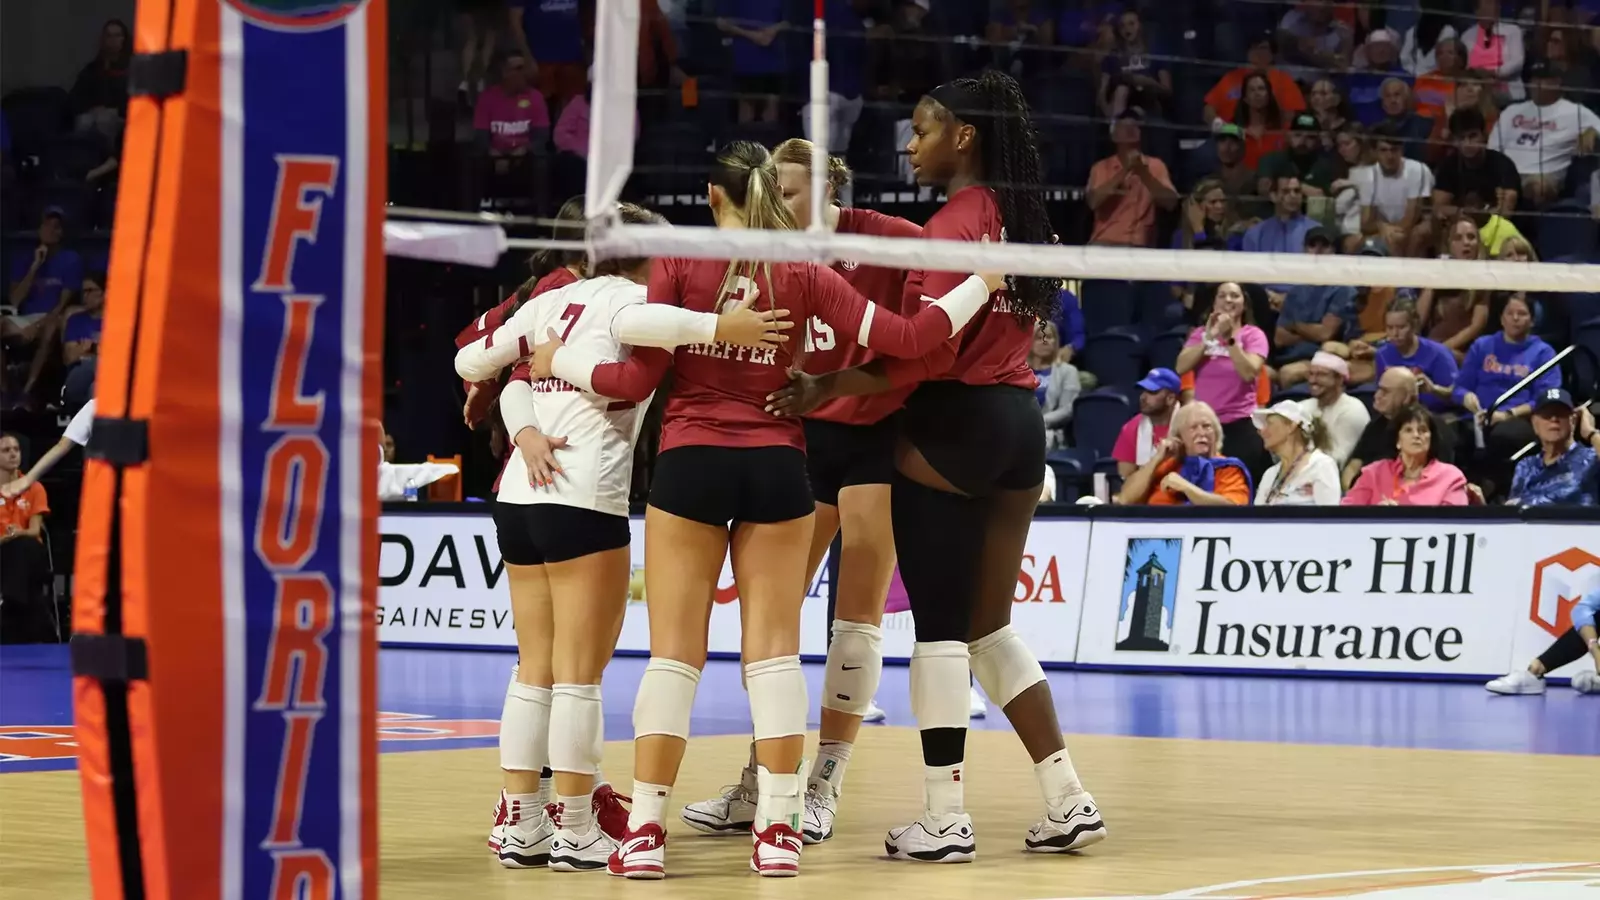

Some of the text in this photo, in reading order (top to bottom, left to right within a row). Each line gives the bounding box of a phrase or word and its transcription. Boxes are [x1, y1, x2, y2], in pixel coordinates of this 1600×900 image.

[560, 303, 586, 344] 7
[1191, 533, 1475, 594] Tower Hill
[376, 606, 515, 630] GAINESV
[1189, 600, 1463, 662] Insurance
